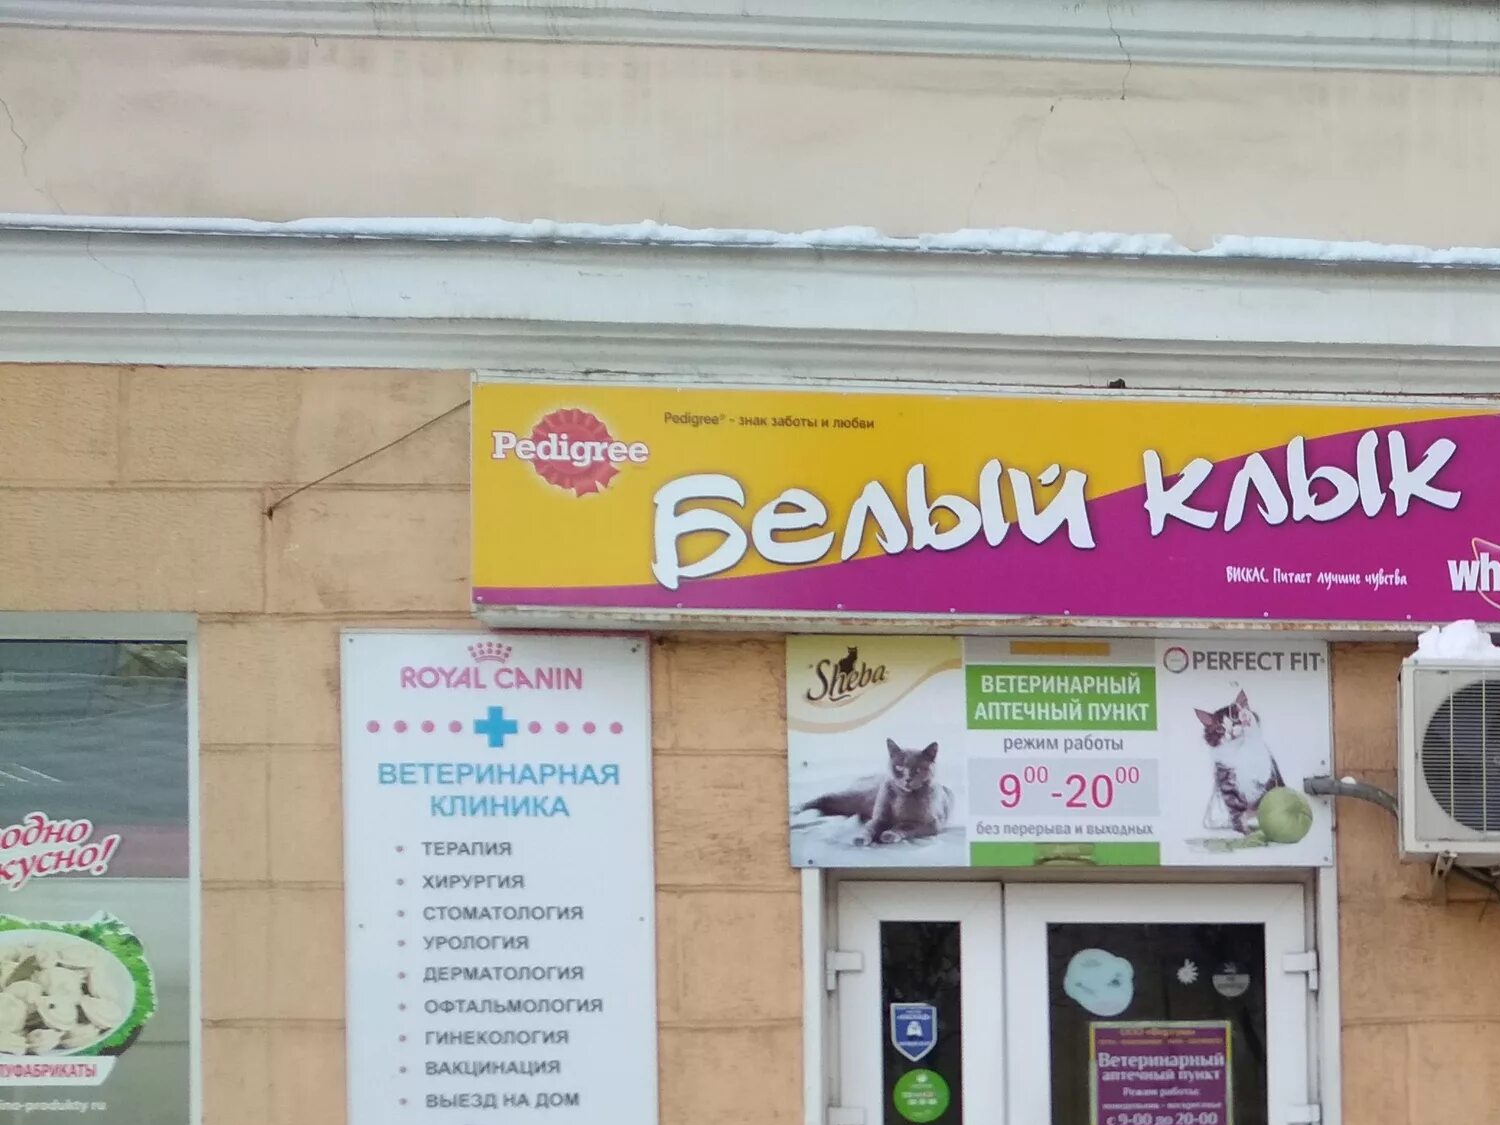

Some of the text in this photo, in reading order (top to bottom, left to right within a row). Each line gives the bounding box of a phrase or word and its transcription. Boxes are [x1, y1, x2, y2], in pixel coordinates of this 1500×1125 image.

[738, 416, 768, 427] знак
[771, 414, 818, 428] заботы
[820, 418, 830, 428] и
[832, 416, 876, 429] любви
[491, 430, 650, 467] Pedigree
[651, 458, 1096, 590] Белый
[1273, 567, 1313, 584] Питает
[1316, 568, 1362, 590] лучшие
[1364, 569, 1408, 591] чувства
[1192, 650, 1285, 671] PERFECT
[401, 666, 583, 690] ROYAL CANIN
[806, 658, 887, 702] Sheba
[981, 672, 1141, 694] ВЕТЕРИНАРНЫЙ
[974, 698, 1150, 722] АПТЕЧНЫЙ ПУНКТ
[1003, 734, 1124, 754] режим работы
[377, 763, 620, 786] ВЕТЕРИНАРНАЯ
[430, 795, 570, 817] КЛИНИКА
[976, 821, 1154, 837] без перерыва и выходных
[422, 842, 512, 856] ТЕРАПИЯ
[422, 874, 525, 889] ХИРУРГИЯ
[422, 906, 584, 921] СТОМАТОЛОГИЯ
[422, 936, 530, 950] УРОЛОГИЯ
[423, 966, 585, 983] ДЕРМАТОЛОГИЯ
[424, 998, 604, 1014] ОФТАЛЬМОЛОГИЯ
[424, 1030, 570, 1045] ГИНЕКОЛОГИЯ
[425, 1060, 562, 1077] ВАКЦИНАЦИЯ
[1098, 1052, 1225, 1069] Ветеринарный
[1101, 1069, 1220, 1083] аптечный пункт
[425, 1092, 580, 1109] ВЫЕЗД НА ДОМ
[1175, 1111, 1219, 1125] 20-00
